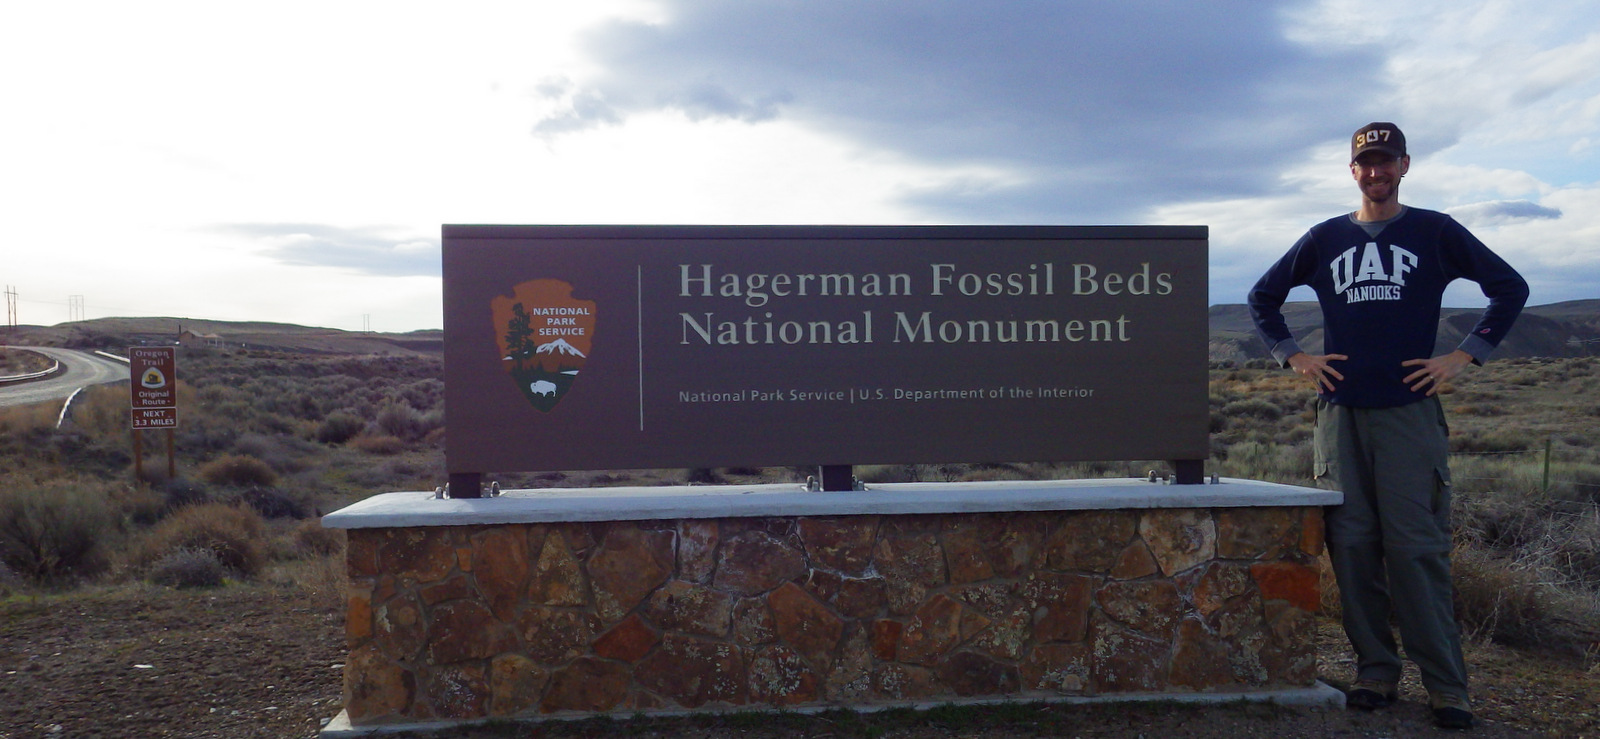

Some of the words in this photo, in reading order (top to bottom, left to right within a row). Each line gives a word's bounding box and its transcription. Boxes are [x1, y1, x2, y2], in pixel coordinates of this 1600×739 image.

[1356, 130, 1391, 148] 307
[1330, 242, 1418, 295] UAF
[679, 264, 912, 307] Hagerman
[930, 263, 1054, 296] Fossil
[1072, 262, 1173, 295] Beds
[1346, 285, 1401, 304] NANOOKS
[533, 307, 590, 315] NATIONAL
[539, 327, 585, 336] SERVICE
[679, 310, 874, 345] National
[893, 311, 1131, 343] Monument
[135, 350, 169, 359] Oregon
[679, 389, 746, 402] National
[751, 389, 785, 401] Park
[789, 388, 844, 401] Service
[859, 388, 888, 400] U.S.
[894, 387, 984, 402] Department
[989, 387, 1004, 399] of
[1009, 386, 1034, 398] the
[1038, 386, 1094, 398] Interior
